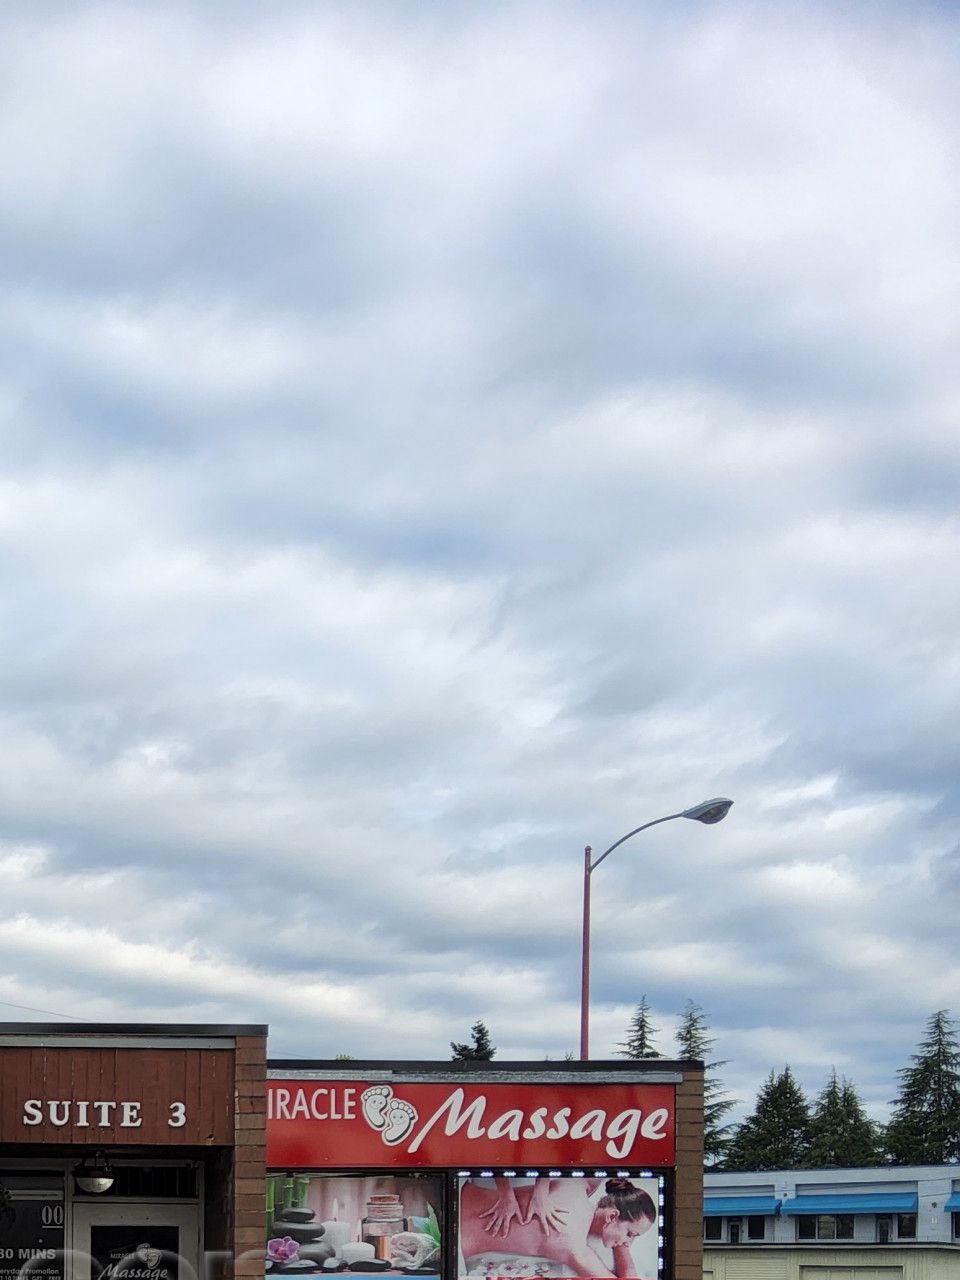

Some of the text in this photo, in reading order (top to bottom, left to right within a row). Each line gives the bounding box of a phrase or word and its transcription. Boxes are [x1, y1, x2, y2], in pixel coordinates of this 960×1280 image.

[23, 1099, 187, 1127] SUITE 3
[268, 1087, 668, 1159] IRACLE Massage
[18, 1248, 56, 1260] MINS
